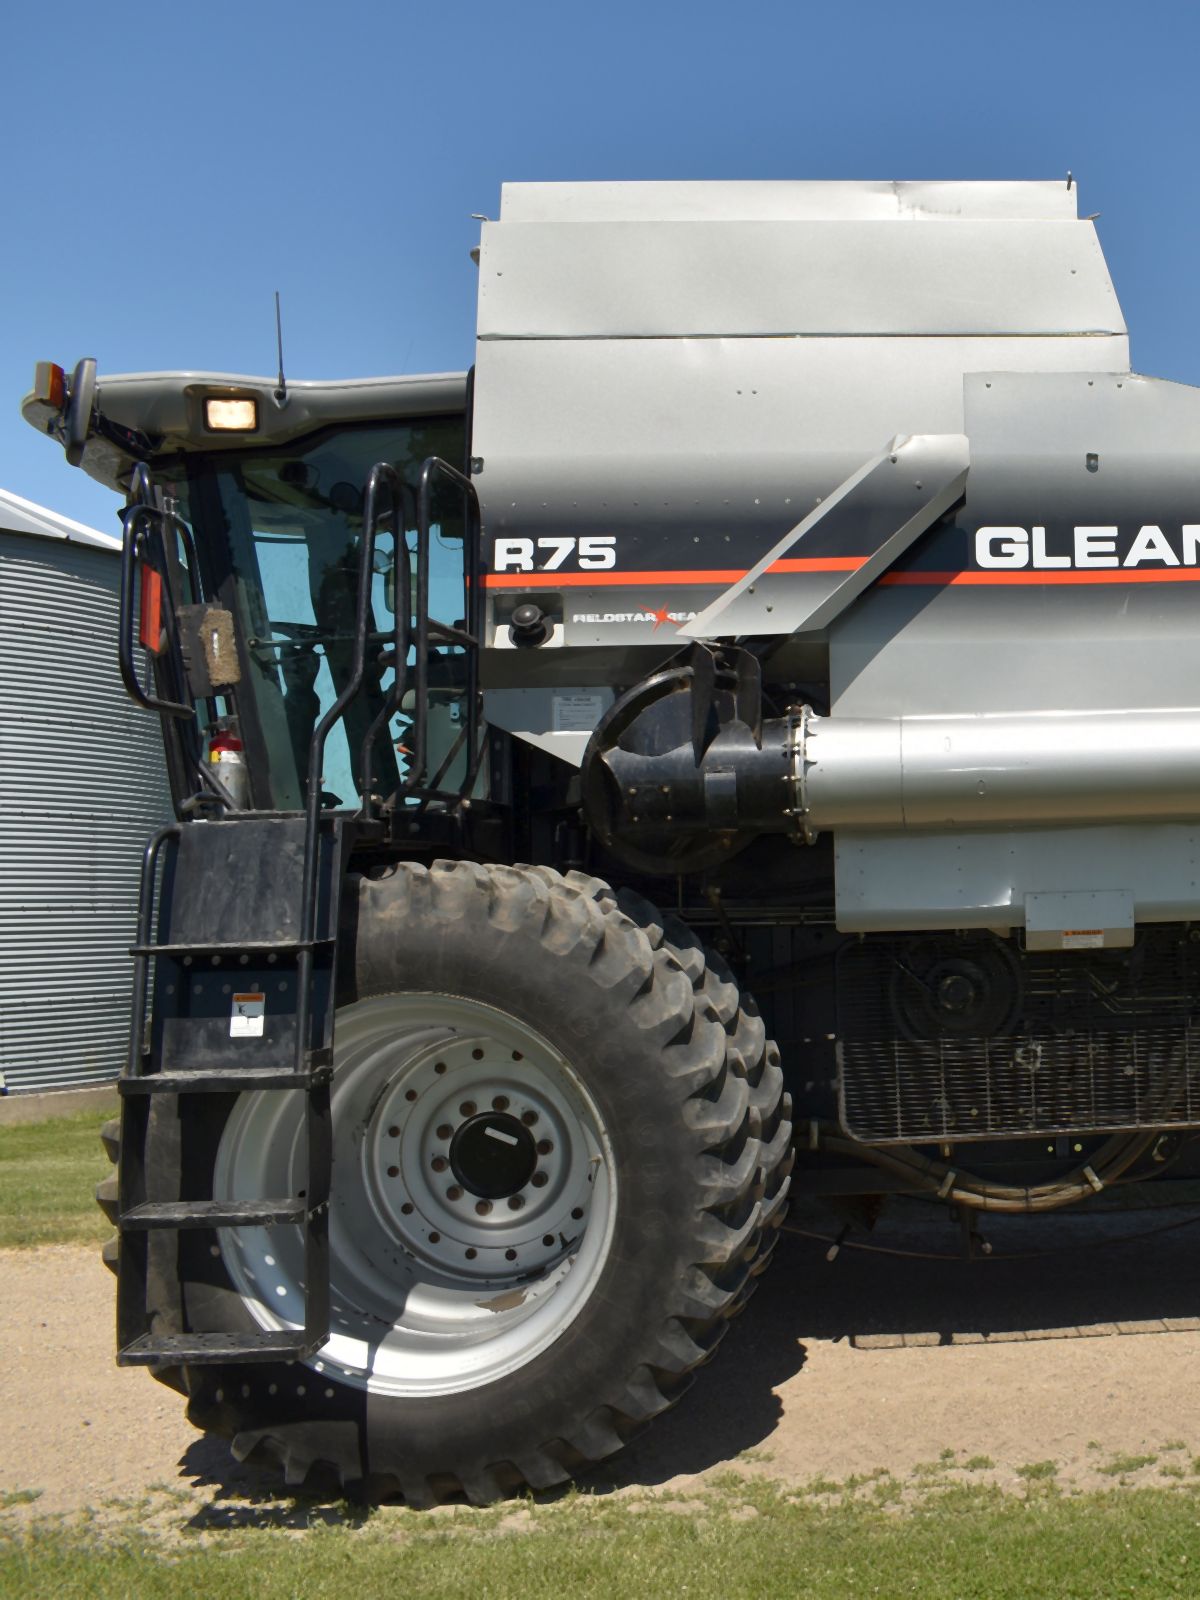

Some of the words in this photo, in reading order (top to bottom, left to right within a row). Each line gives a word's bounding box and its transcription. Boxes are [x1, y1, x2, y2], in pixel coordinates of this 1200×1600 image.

[494, 536, 617, 571] R75
[572, 612, 657, 624] FIELDSTAR
[666, 611, 702, 622] REA
